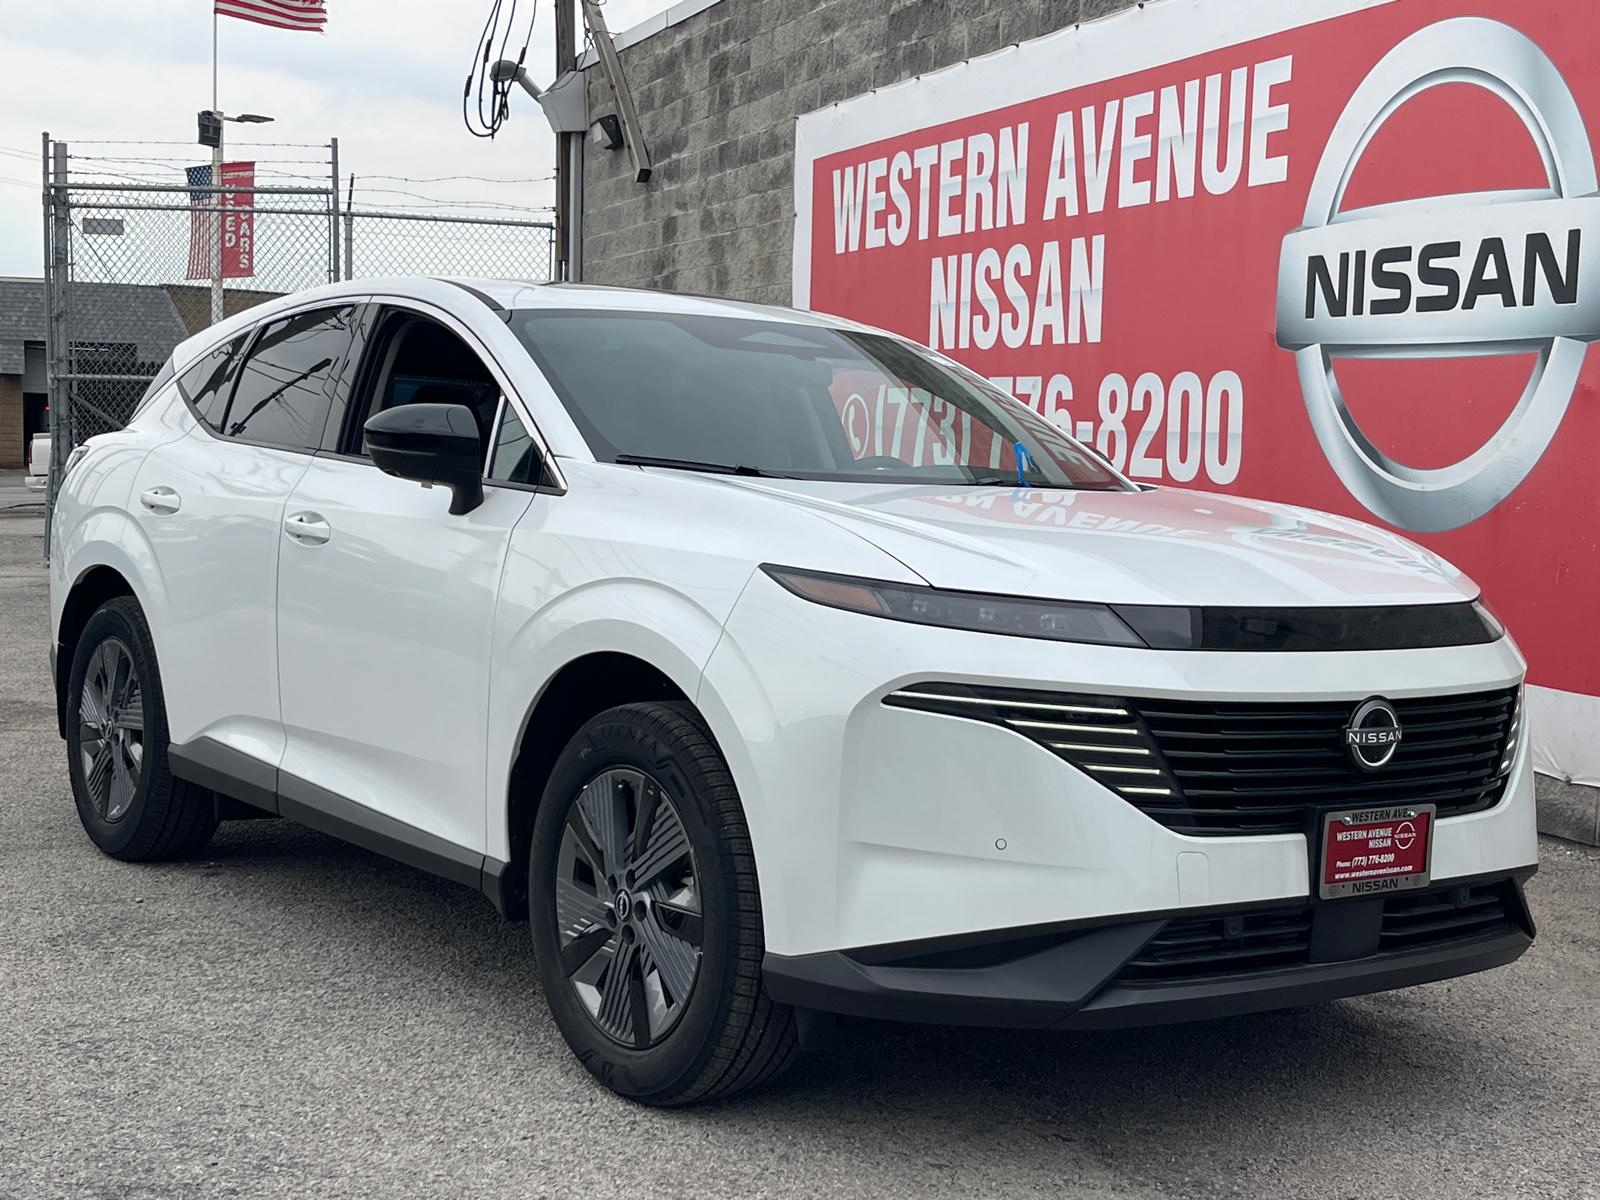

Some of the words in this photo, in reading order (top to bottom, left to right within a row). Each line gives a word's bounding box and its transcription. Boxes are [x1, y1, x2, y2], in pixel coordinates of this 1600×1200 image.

[832, 123, 1028, 254] WESTERN
[1043, 55, 1293, 221] AVENUE
[1305, 229, 1582, 319] NISSAN
[929, 235, 1106, 350] NISSAN
[1348, 729, 1402, 743] NISSAN
[1352, 810, 1391, 823] WESTERN
[1337, 831, 1367, 841] WESTERN
[1367, 828, 1392, 838] AVENUE
[1368, 838, 1392, 849] NISSAN
[1351, 855, 1368, 868] (773)
[1368, 853, 1395, 865] 776-8200
[1335, 866, 1413, 879] www.westernavenissan.com
[1352, 879, 1398, 893] NISSAN
